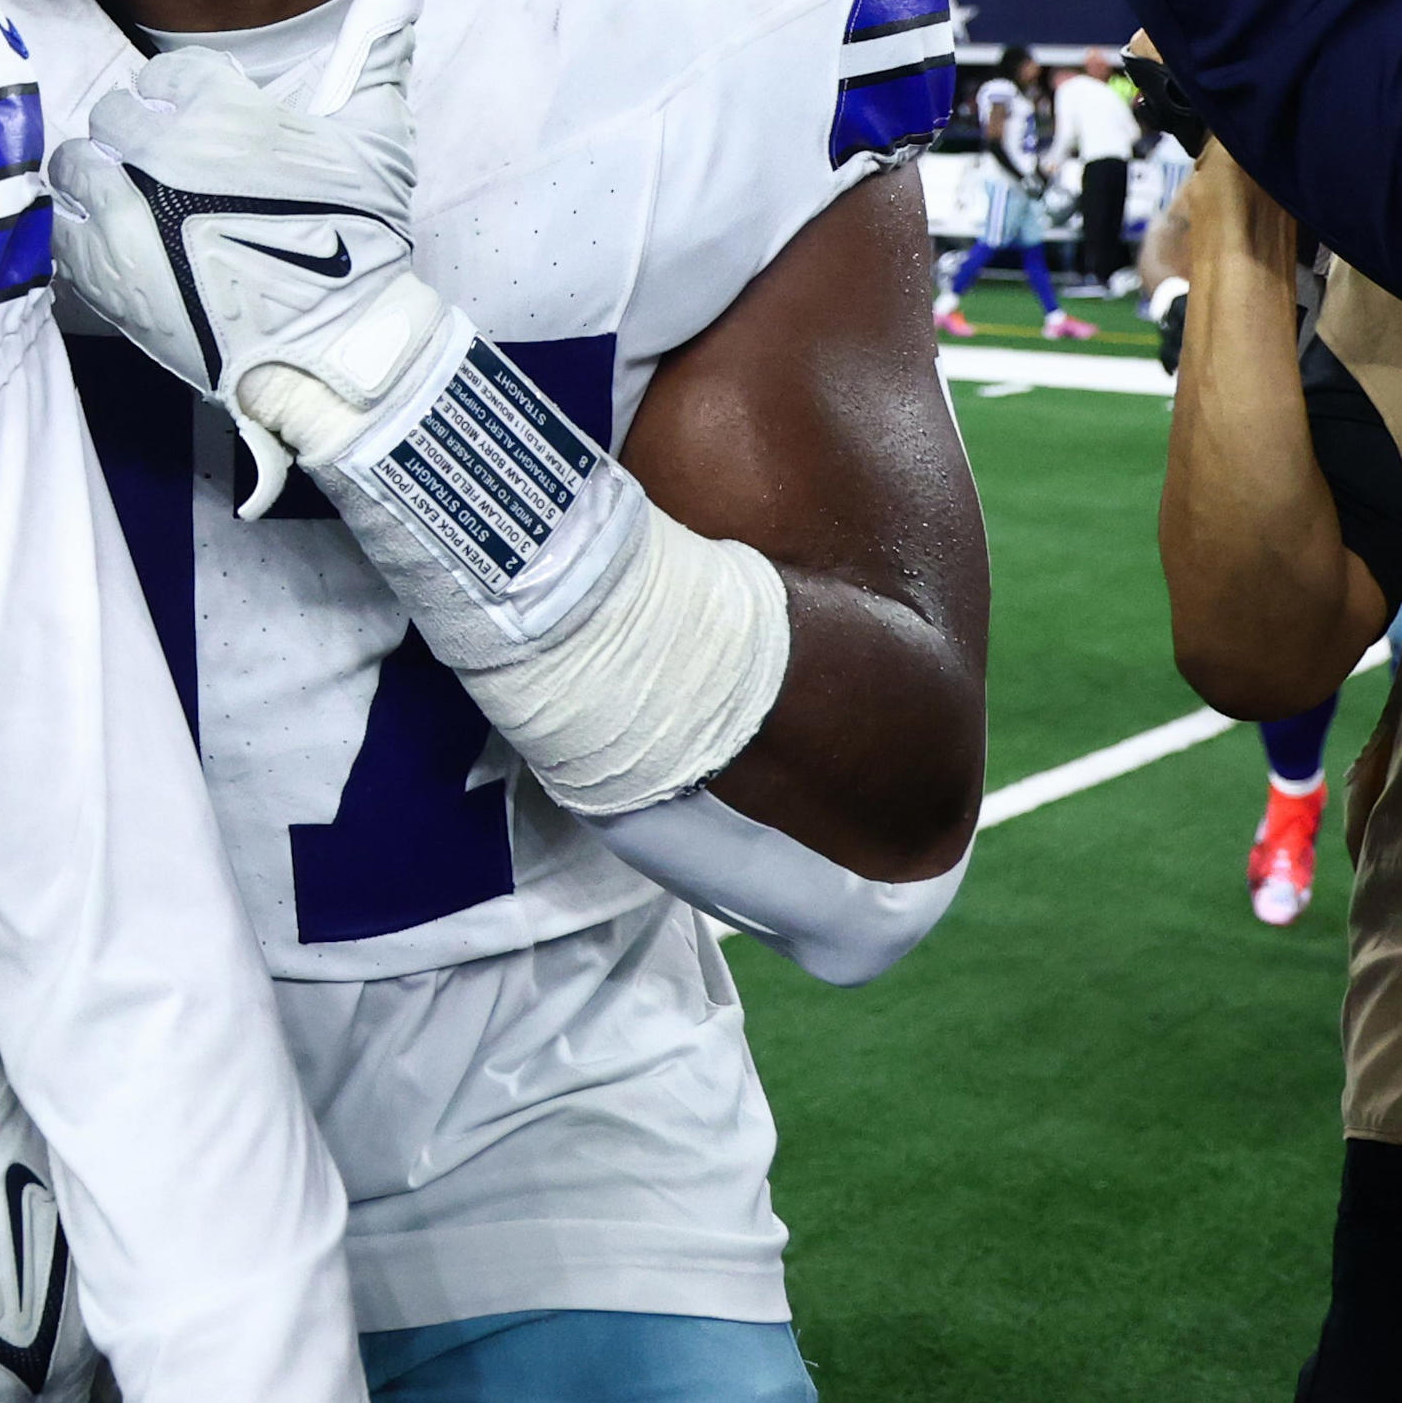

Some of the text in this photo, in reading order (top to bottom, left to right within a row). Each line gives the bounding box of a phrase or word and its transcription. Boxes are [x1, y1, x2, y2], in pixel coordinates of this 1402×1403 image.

[458, 363, 482, 387] (BDR
[480, 385, 515, 423] BOUNCE
[442, 401, 480, 442] MIDDLE
[484, 418, 516, 449] ALERT
[494, 370, 590, 470] 8 STRAIGHT
[415, 434, 454, 475] MIDDLE
[446, 435, 475, 468] TASER
[478, 440, 507, 470] BDRY
[545, 452, 566, 477] TEAR
[473, 464, 500, 492] FIELD
[512, 448, 557, 494] STRAIGHT
[566, 475, 578, 489] 7
[451, 472, 481, 503] FIELD
[496, 487, 512, 506] TO
[504, 467, 546, 510] OUTLAW
[556, 489, 568, 505] 6
[404, 457, 520, 571] 2 STUD STRAIGHT
[410, 494, 441, 523] EASY
[477, 500, 520, 543] OUTLAW
[509, 500, 533, 528] WIDE
[544, 506, 557, 521] 5
[437, 519, 465, 548] PICK
[531, 523, 545, 536] 4
[462, 544, 492, 575] EVEN
[519, 539, 532, 555] 3
[489, 572, 502, 585] 1
